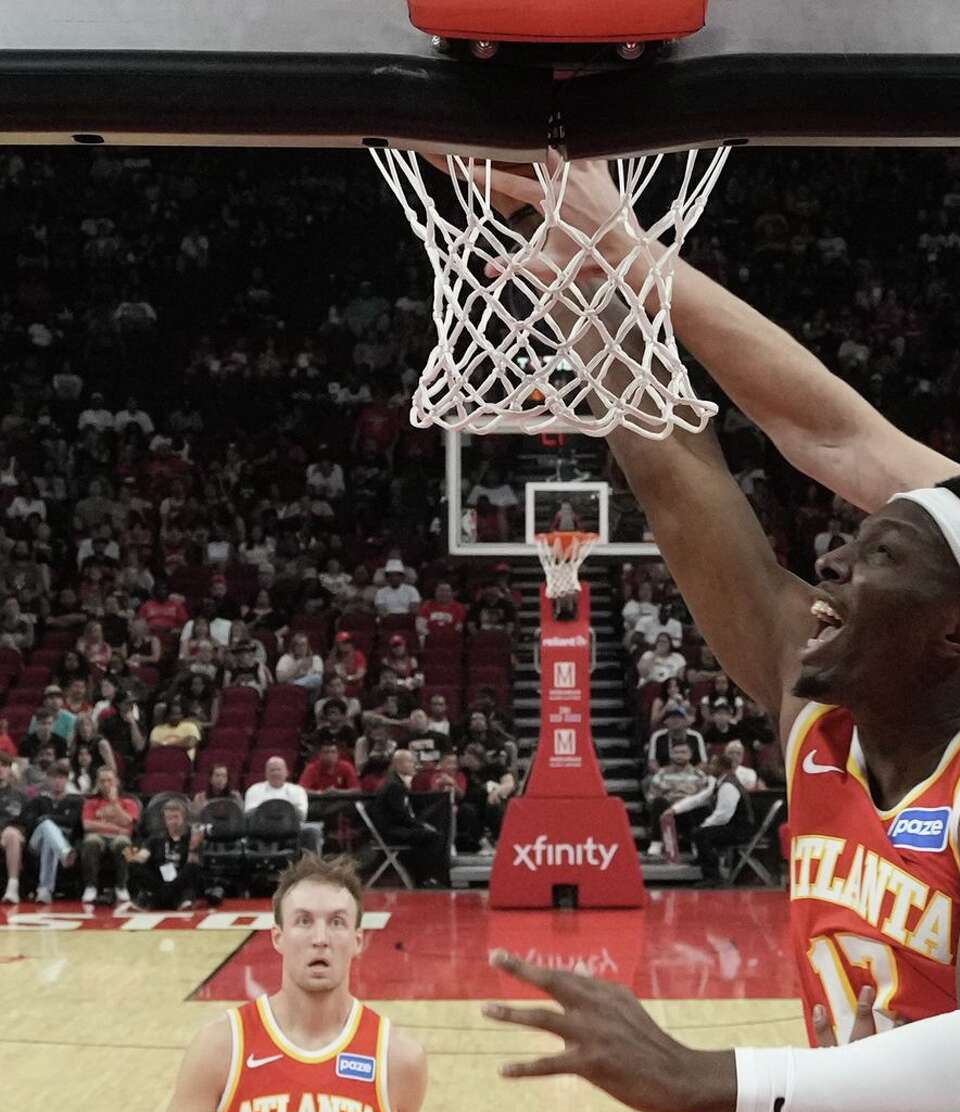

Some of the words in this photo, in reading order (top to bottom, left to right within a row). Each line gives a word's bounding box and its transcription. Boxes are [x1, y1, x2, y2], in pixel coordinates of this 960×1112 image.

[892, 817, 944, 837] paze
[512, 834, 619, 871] xfinity
[340, 1060, 373, 1073] paze
